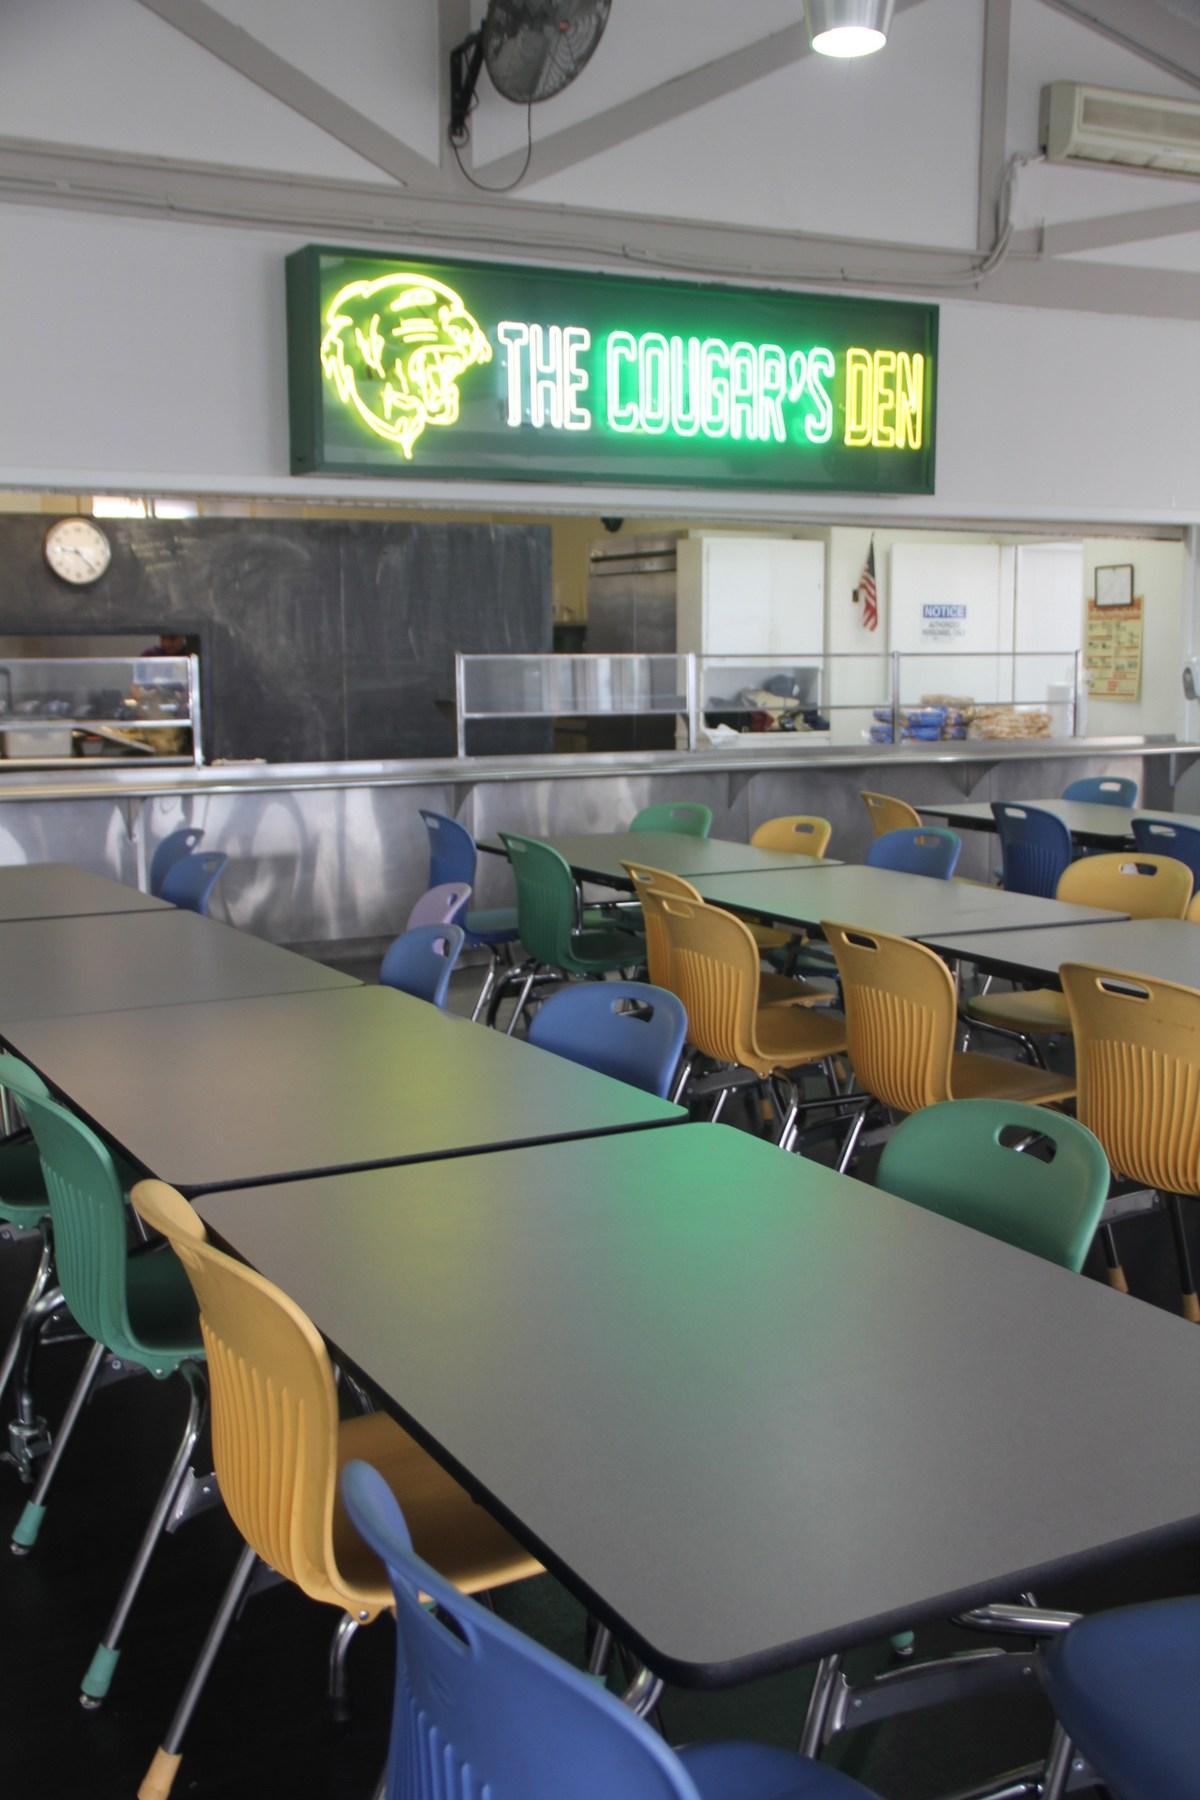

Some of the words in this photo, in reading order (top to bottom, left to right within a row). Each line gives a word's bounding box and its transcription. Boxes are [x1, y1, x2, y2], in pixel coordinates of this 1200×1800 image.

[497, 321, 591, 430] THE
[607, 331, 835, 444] COUGAR'S
[844, 347, 924, 450] DEN
[924, 606, 965, 617] NOTICE
